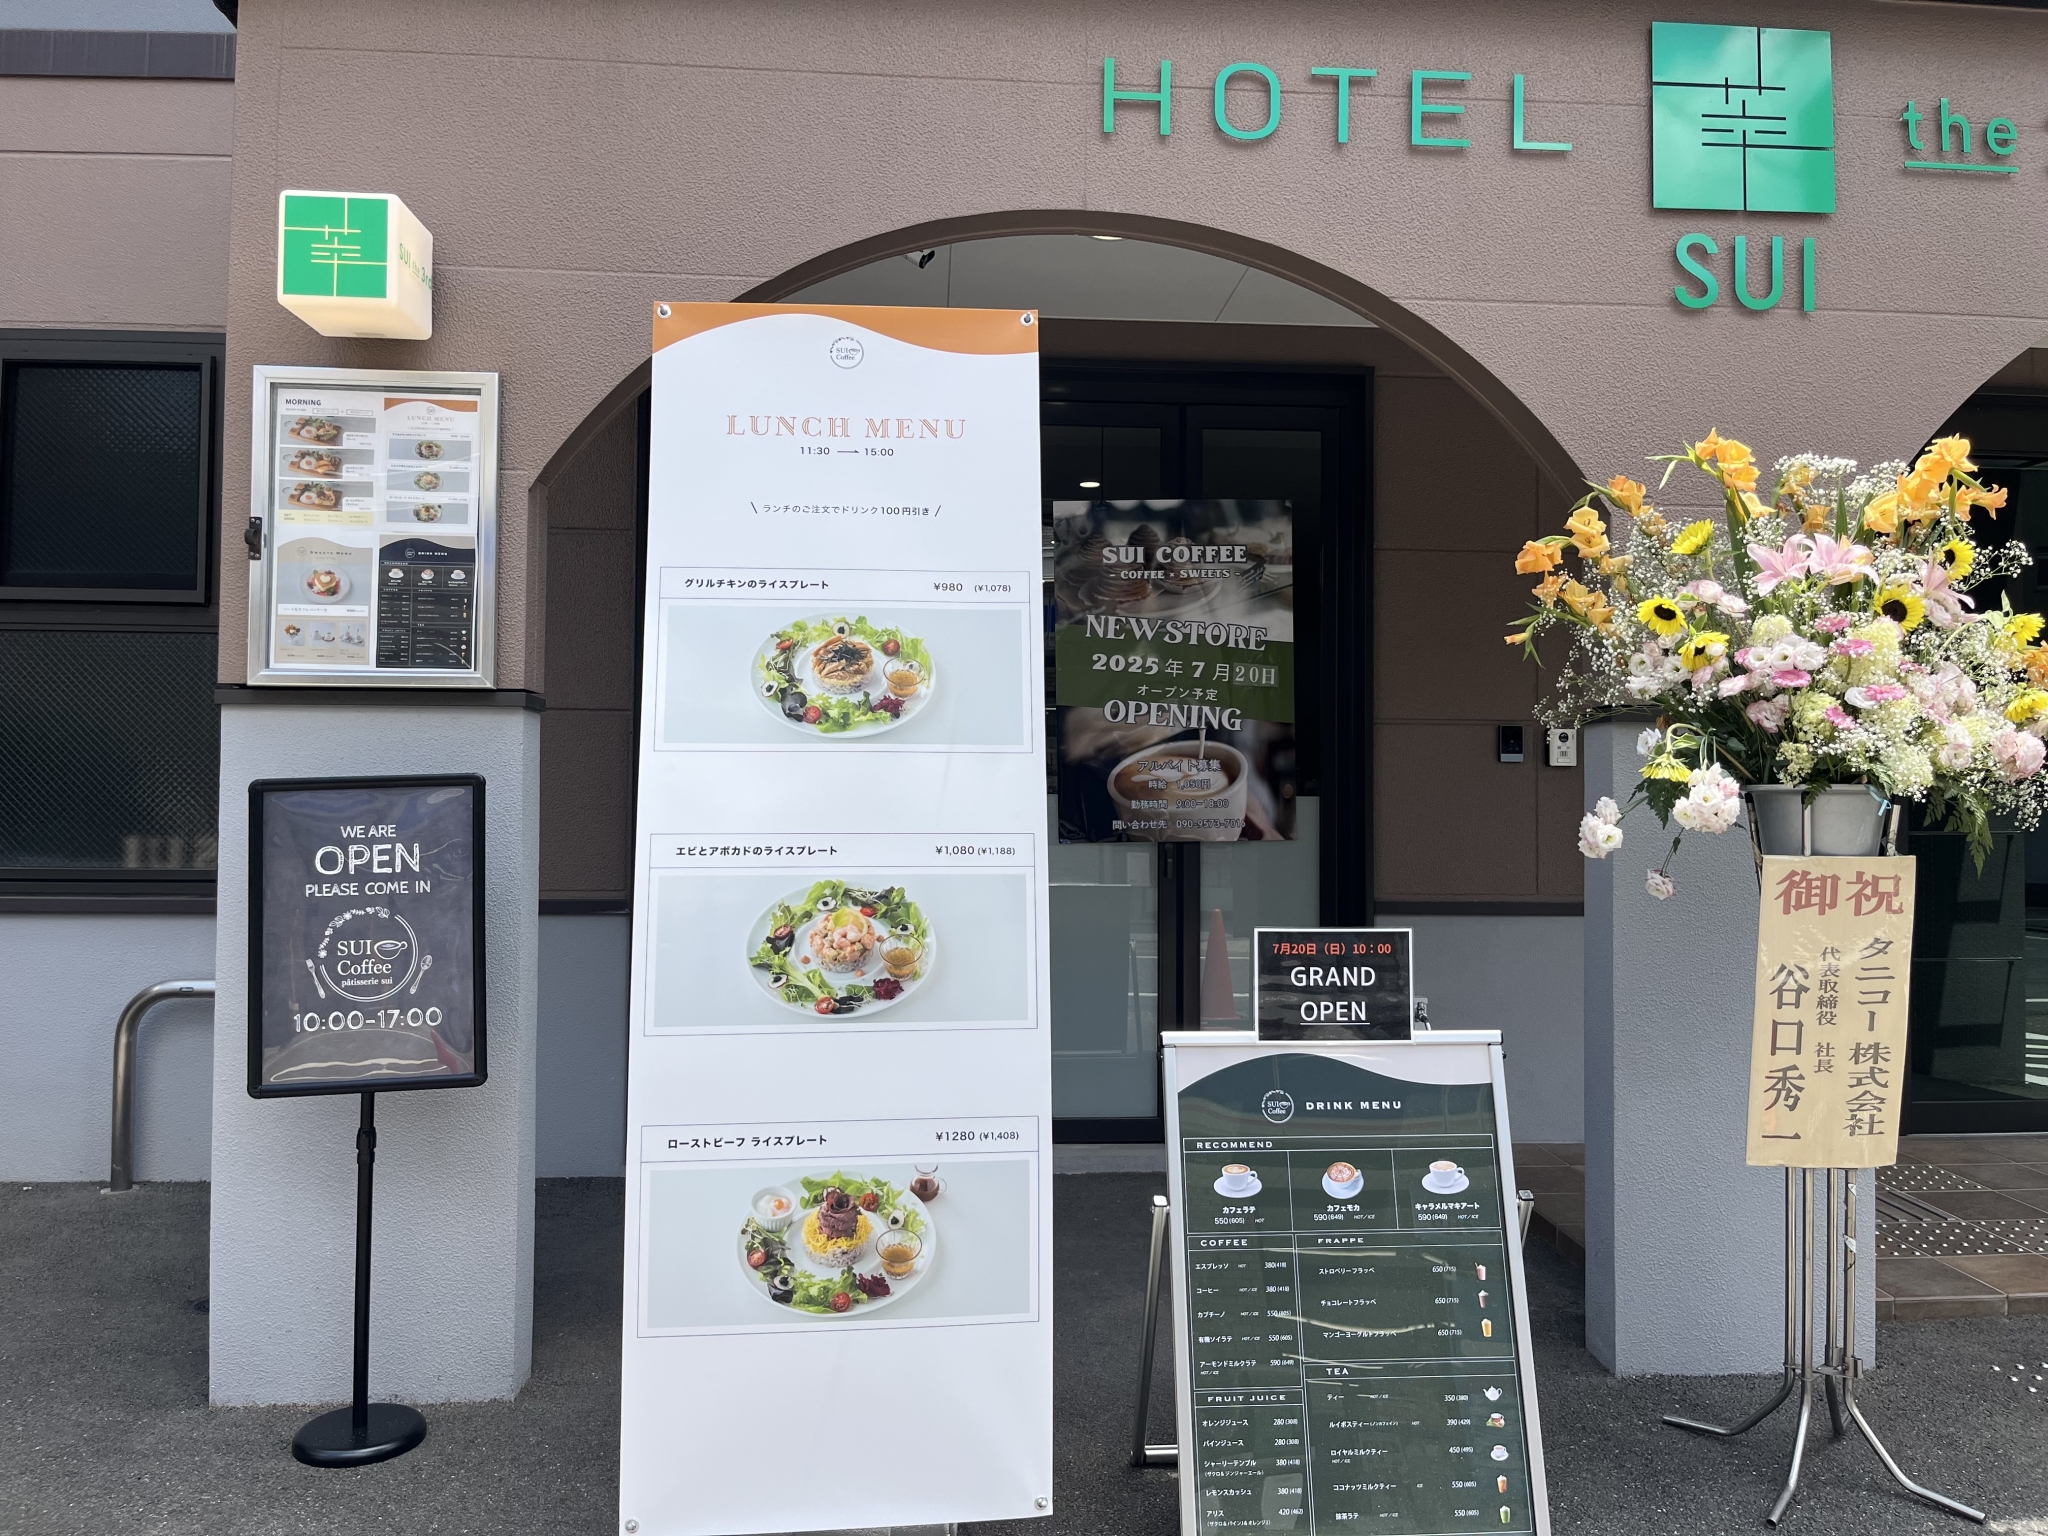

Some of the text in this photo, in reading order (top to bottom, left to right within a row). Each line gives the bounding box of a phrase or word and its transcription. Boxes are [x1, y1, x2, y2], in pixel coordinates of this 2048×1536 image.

[1103, 56, 1573, 152] HOTEL
[1902, 97, 2018, 155] the
[399, 243, 411, 268] SUI
[1673, 232, 1816, 312] SUI
[726, 414, 966, 439] LUNCH MENU
[799, 446, 894, 457] 11:30 15:00
[1102, 545, 1248, 564] SUI COFFEE
[1120, 569, 1231, 579] COFFEE SWEETS
[684, 577, 1011, 593] グリルチキンのライスプレート ¥980 (¥1,078)
[1137, 684, 1218, 701] オープン予定
[1103, 699, 1242, 731] OPENING
[1137, 759, 1221, 772] アルバイト募集
[1148, 780, 1167, 789] 時給
[1130, 800, 1168, 809] 勤務時間
[340, 824, 396, 838] WE ARE
[1112, 820, 1167, 830] 問い合わせ先
[675, 845, 1015, 857] エビとアボカドのライスプレート ¥1,080 (¥1,188)
[315, 843, 420, 875] OPEN
[305, 880, 431, 897] PLEASE COME IN
[1774, 869, 1904, 917] 御祝
[337, 940, 372, 956] SUI
[337, 958, 392, 976] Coffee
[381, 976, 393, 985] sui
[1290, 966, 1376, 987] GRAND
[1300, 1001, 1366, 1022] OPEN
[1814, 946, 1841, 1074] 代表取締役 社長
[1843, 937, 1896, 1137] タニコー 株式会社
[1761, 963, 1811, 1141] 谷口秀一
[1305, 1101, 1401, 1110] DRINK MENU
[668, 1130, 1019, 1149] ローストビーフ ライスプレート ¥1280 (¥1,408)
[1196, 1141, 1273, 1149] RECOMMEND
[1222, 1206, 1256, 1214] カフェラテ
[1326, 1204, 1360, 1212] カフェモカ
[1415, 1202, 1480, 1210] キャラメルマキアート
[1200, 1238, 1248, 1247] COFFEE
[1318, 1267, 1375, 1275] ストロベリーフラッペ
[1202, 1419, 1249, 1427] オレンジジュース
[1330, 1448, 1388, 1456] ロイヤルミルクティー
[1206, 1488, 1252, 1496] レモンスカッシュ
[1333, 1483, 1396, 1491] ココナッツミルクティー
